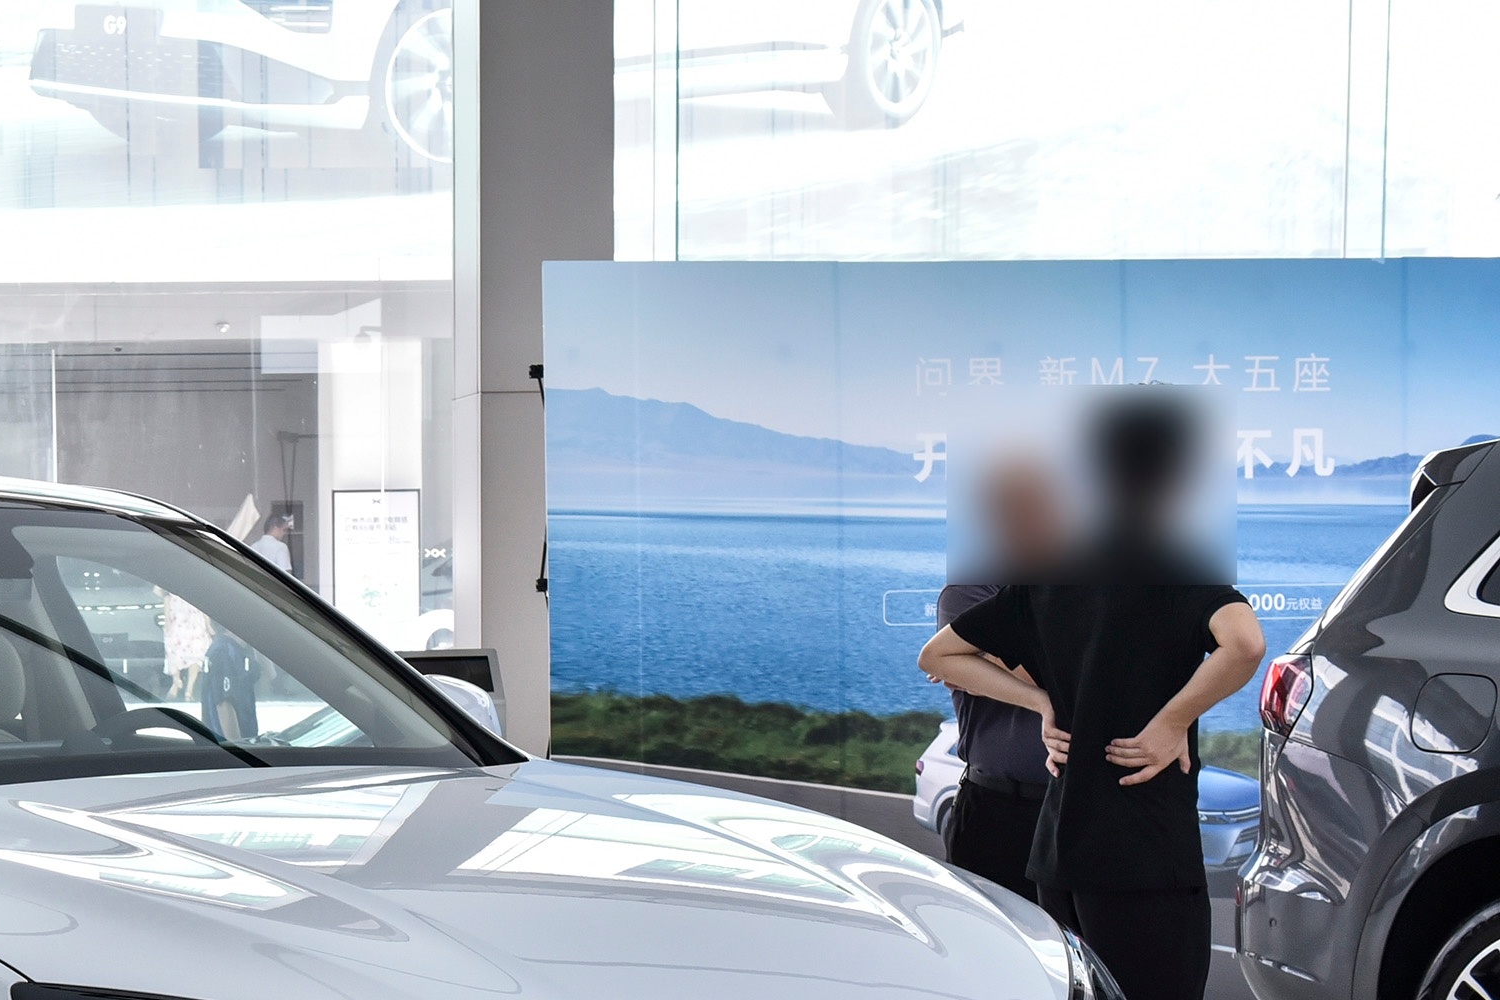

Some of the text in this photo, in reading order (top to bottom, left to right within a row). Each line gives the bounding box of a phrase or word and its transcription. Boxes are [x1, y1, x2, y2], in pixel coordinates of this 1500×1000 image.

[103, 14, 126, 35] G9
[915, 356, 1005, 397] 问界
[1192, 352, 1332, 393] 大五座
